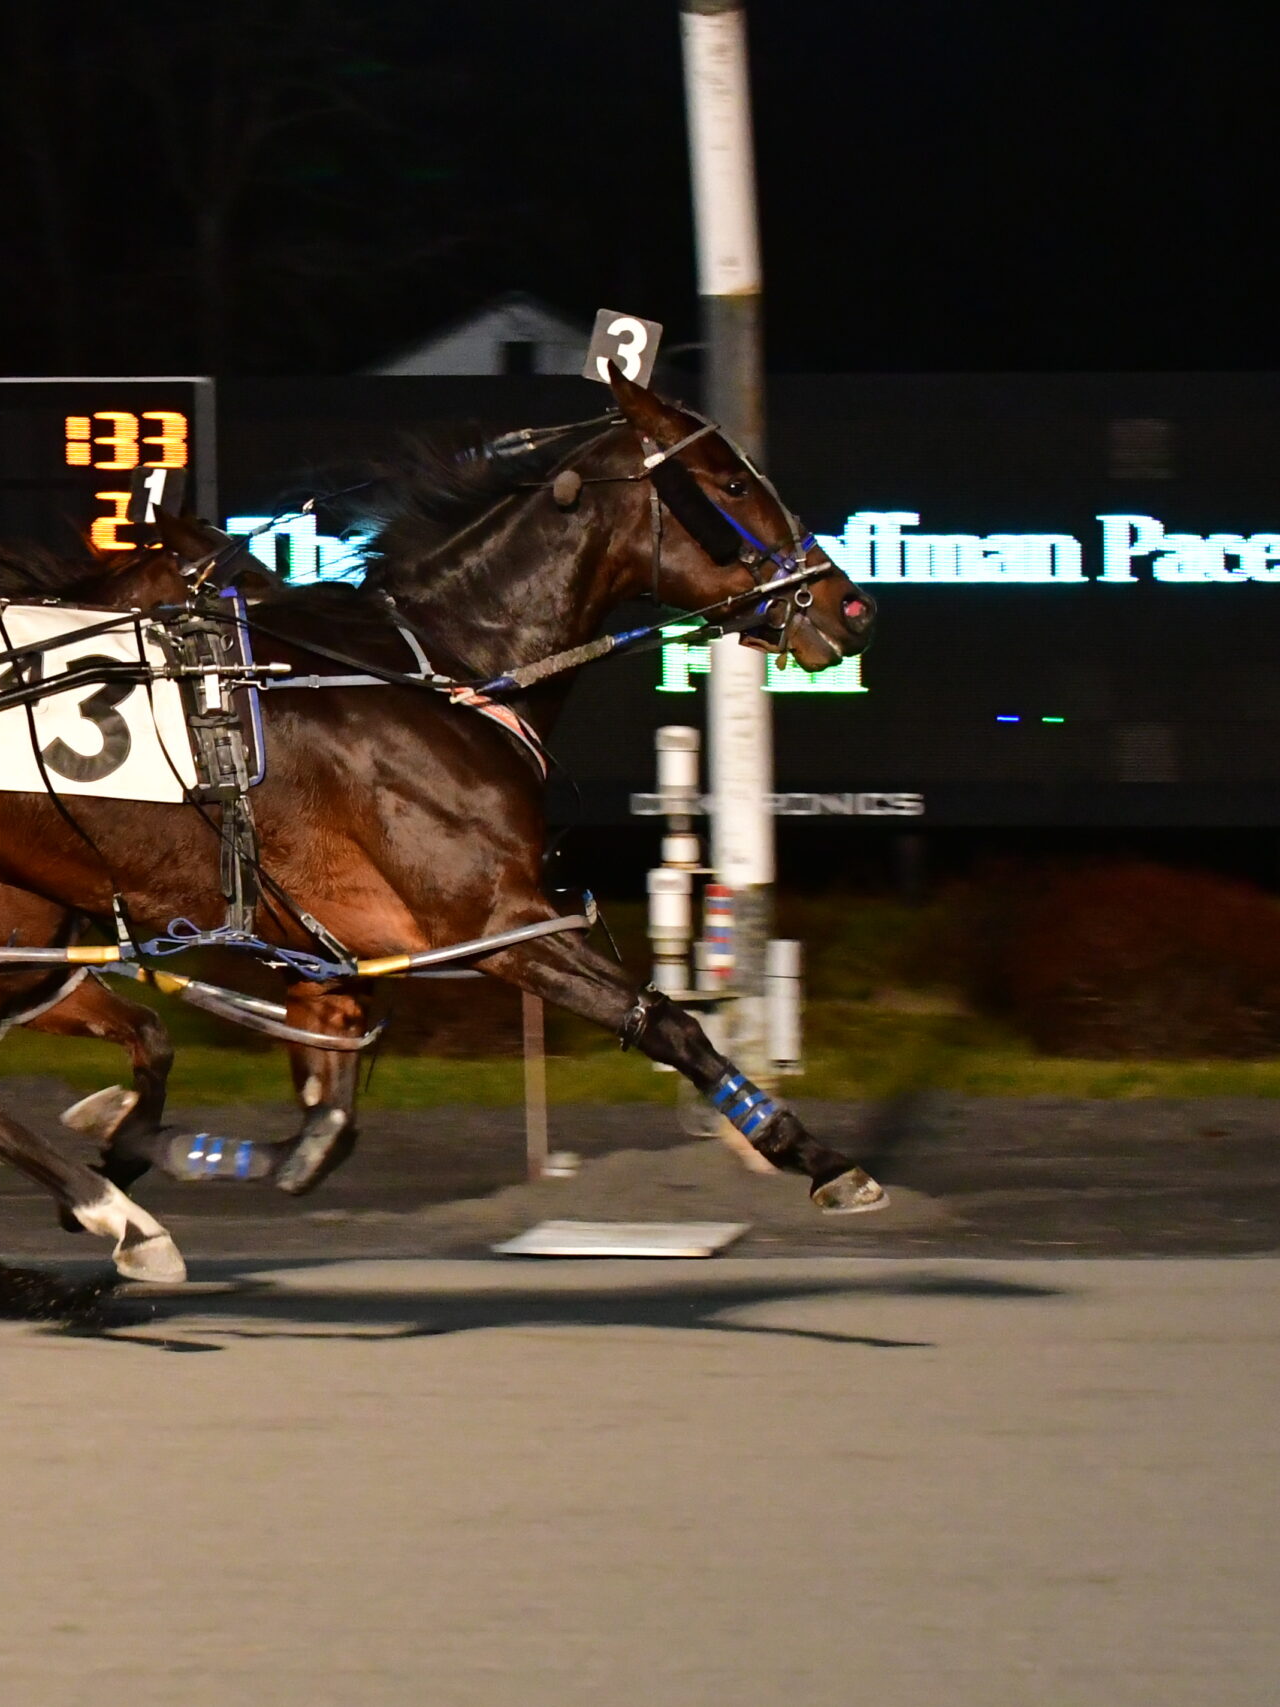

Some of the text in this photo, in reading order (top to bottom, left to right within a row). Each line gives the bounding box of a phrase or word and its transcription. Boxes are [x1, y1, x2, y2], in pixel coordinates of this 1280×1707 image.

[596, 317, 647, 385] 3
[143, 468, 167, 524] 1
[41, 653, 133, 783] 3
